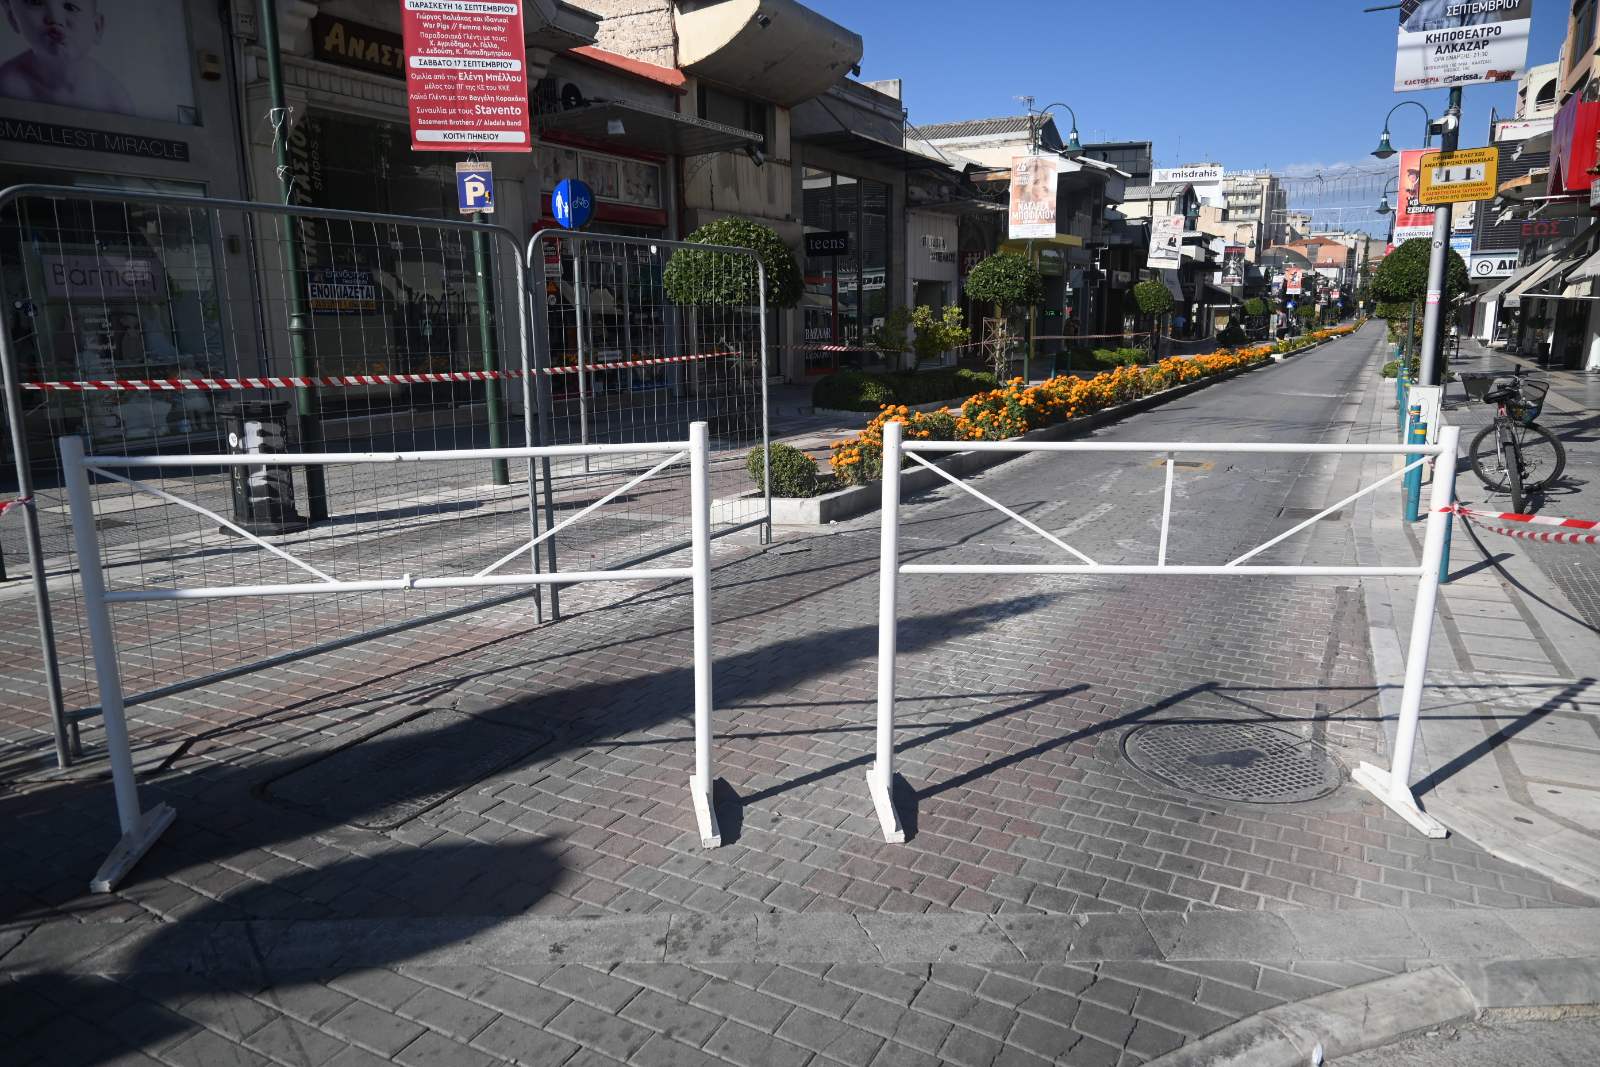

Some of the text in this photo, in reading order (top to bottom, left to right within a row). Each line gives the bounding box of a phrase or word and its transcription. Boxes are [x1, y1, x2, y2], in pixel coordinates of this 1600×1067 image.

[409, 1, 515, 13] ΠΑΡΑΣΚΕΥΗ 16 ΣΕΠΤΕΜΒΡΙΟΥ
[1446, 0, 1520, 17] ΣΕΠΤΕΜΒΡΙΟΥ
[1425, 26, 1502, 44] ΚΗΠΟΘΕΑΤΡΟ
[1435, 40, 1490, 55] ΑΛΚΑΖΑΡ
[419, 58, 452, 67] ΣΑΒΒΑΤΟ
[463, 60, 512, 69] ΣΕΠΤΕΜΒΡΙΟΥ
[458, 72, 484, 83] Ελένη
[485, 73, 521, 83] Μπέλλου
[424, 83, 443, 92] μέλος
[474, 104, 522, 116] Stavento
[443, 132, 499, 142] ΚΟΙΤΗ ΠΗΝΕΙΟΥ
[104, 134, 186, 160] MIRACLE
[1171, 169, 1218, 180] misdrahis
[465, 181, 486, 206] P
[809, 238, 845, 251] teens
